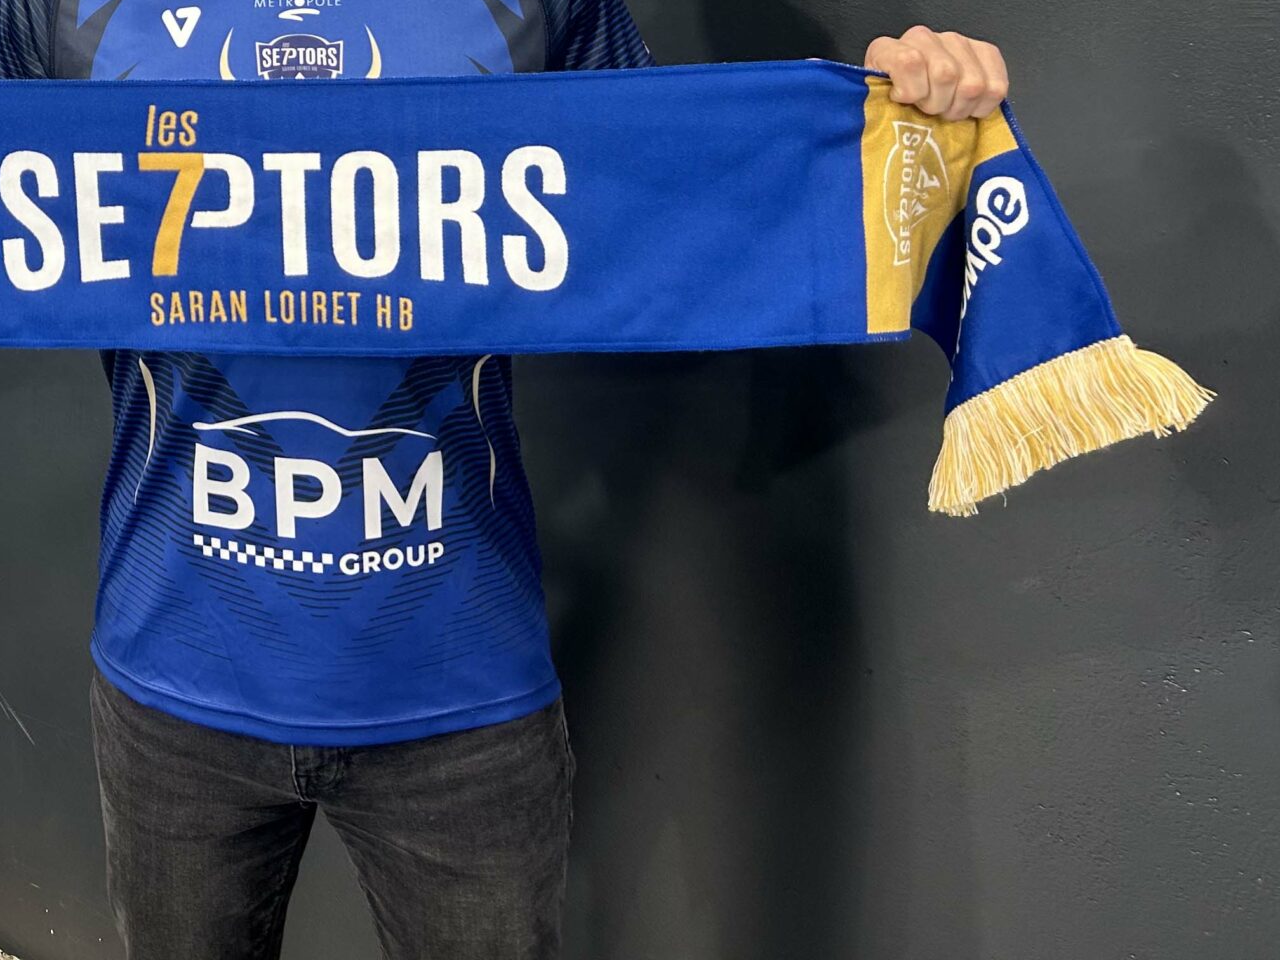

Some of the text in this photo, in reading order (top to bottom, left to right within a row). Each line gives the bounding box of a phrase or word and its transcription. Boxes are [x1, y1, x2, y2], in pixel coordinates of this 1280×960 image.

[145, 104, 198, 147] les
[150, 290, 414, 331] SARAN LOIRET HB
[193, 442, 444, 540] BPM
[339, 541, 445, 576] GROUP
